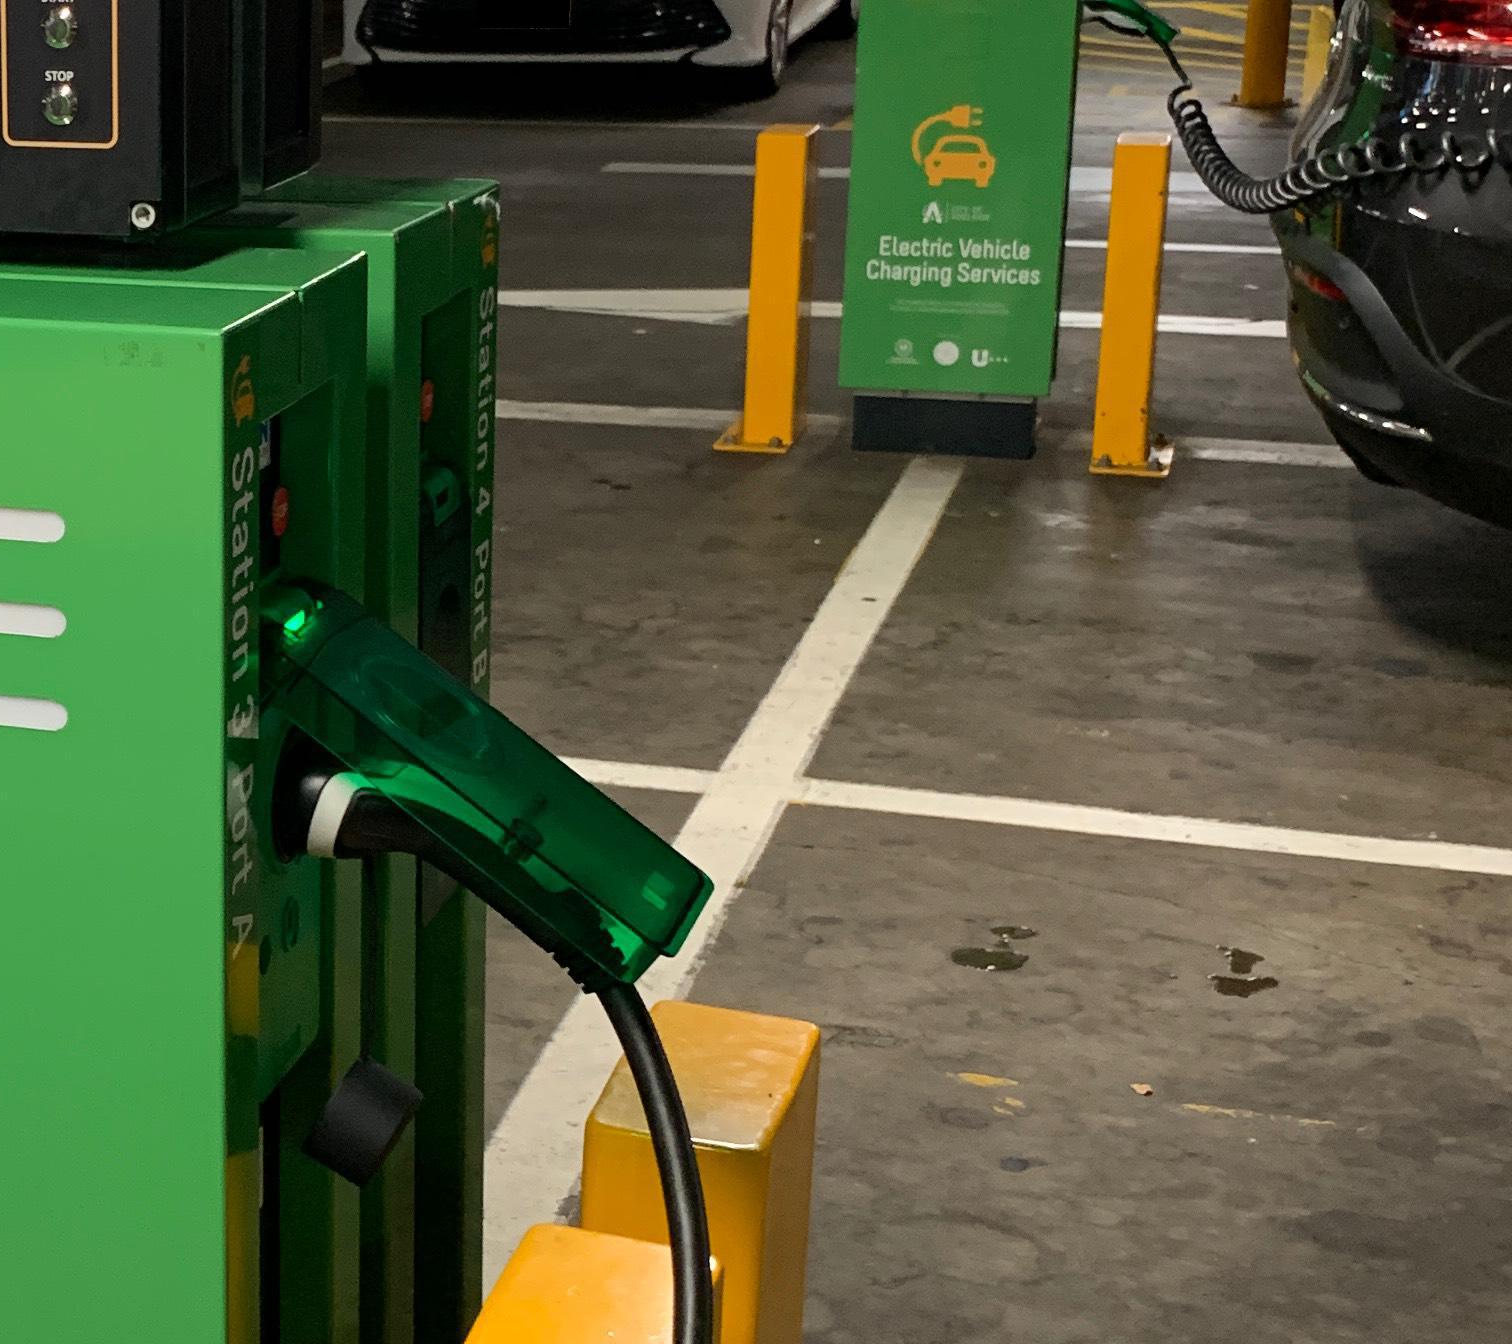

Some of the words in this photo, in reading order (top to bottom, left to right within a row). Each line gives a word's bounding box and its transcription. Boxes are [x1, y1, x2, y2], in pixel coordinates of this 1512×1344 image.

[44, 70, 74, 82] STOP
[878, 234, 954, 258] Electric
[958, 237, 1032, 261] Vehicle
[866, 258, 953, 288] Charging
[956, 261, 1041, 286] Services
[476, 286, 495, 473] Station
[474, 486, 490, 517] 4
[229, 446, 255, 683] Station
[472, 537, 490, 644] Port
[472, 657, 487, 685] B
[229, 692, 255, 739] 3
[232, 763, 255, 896] Port
[232, 913, 254, 960] A
